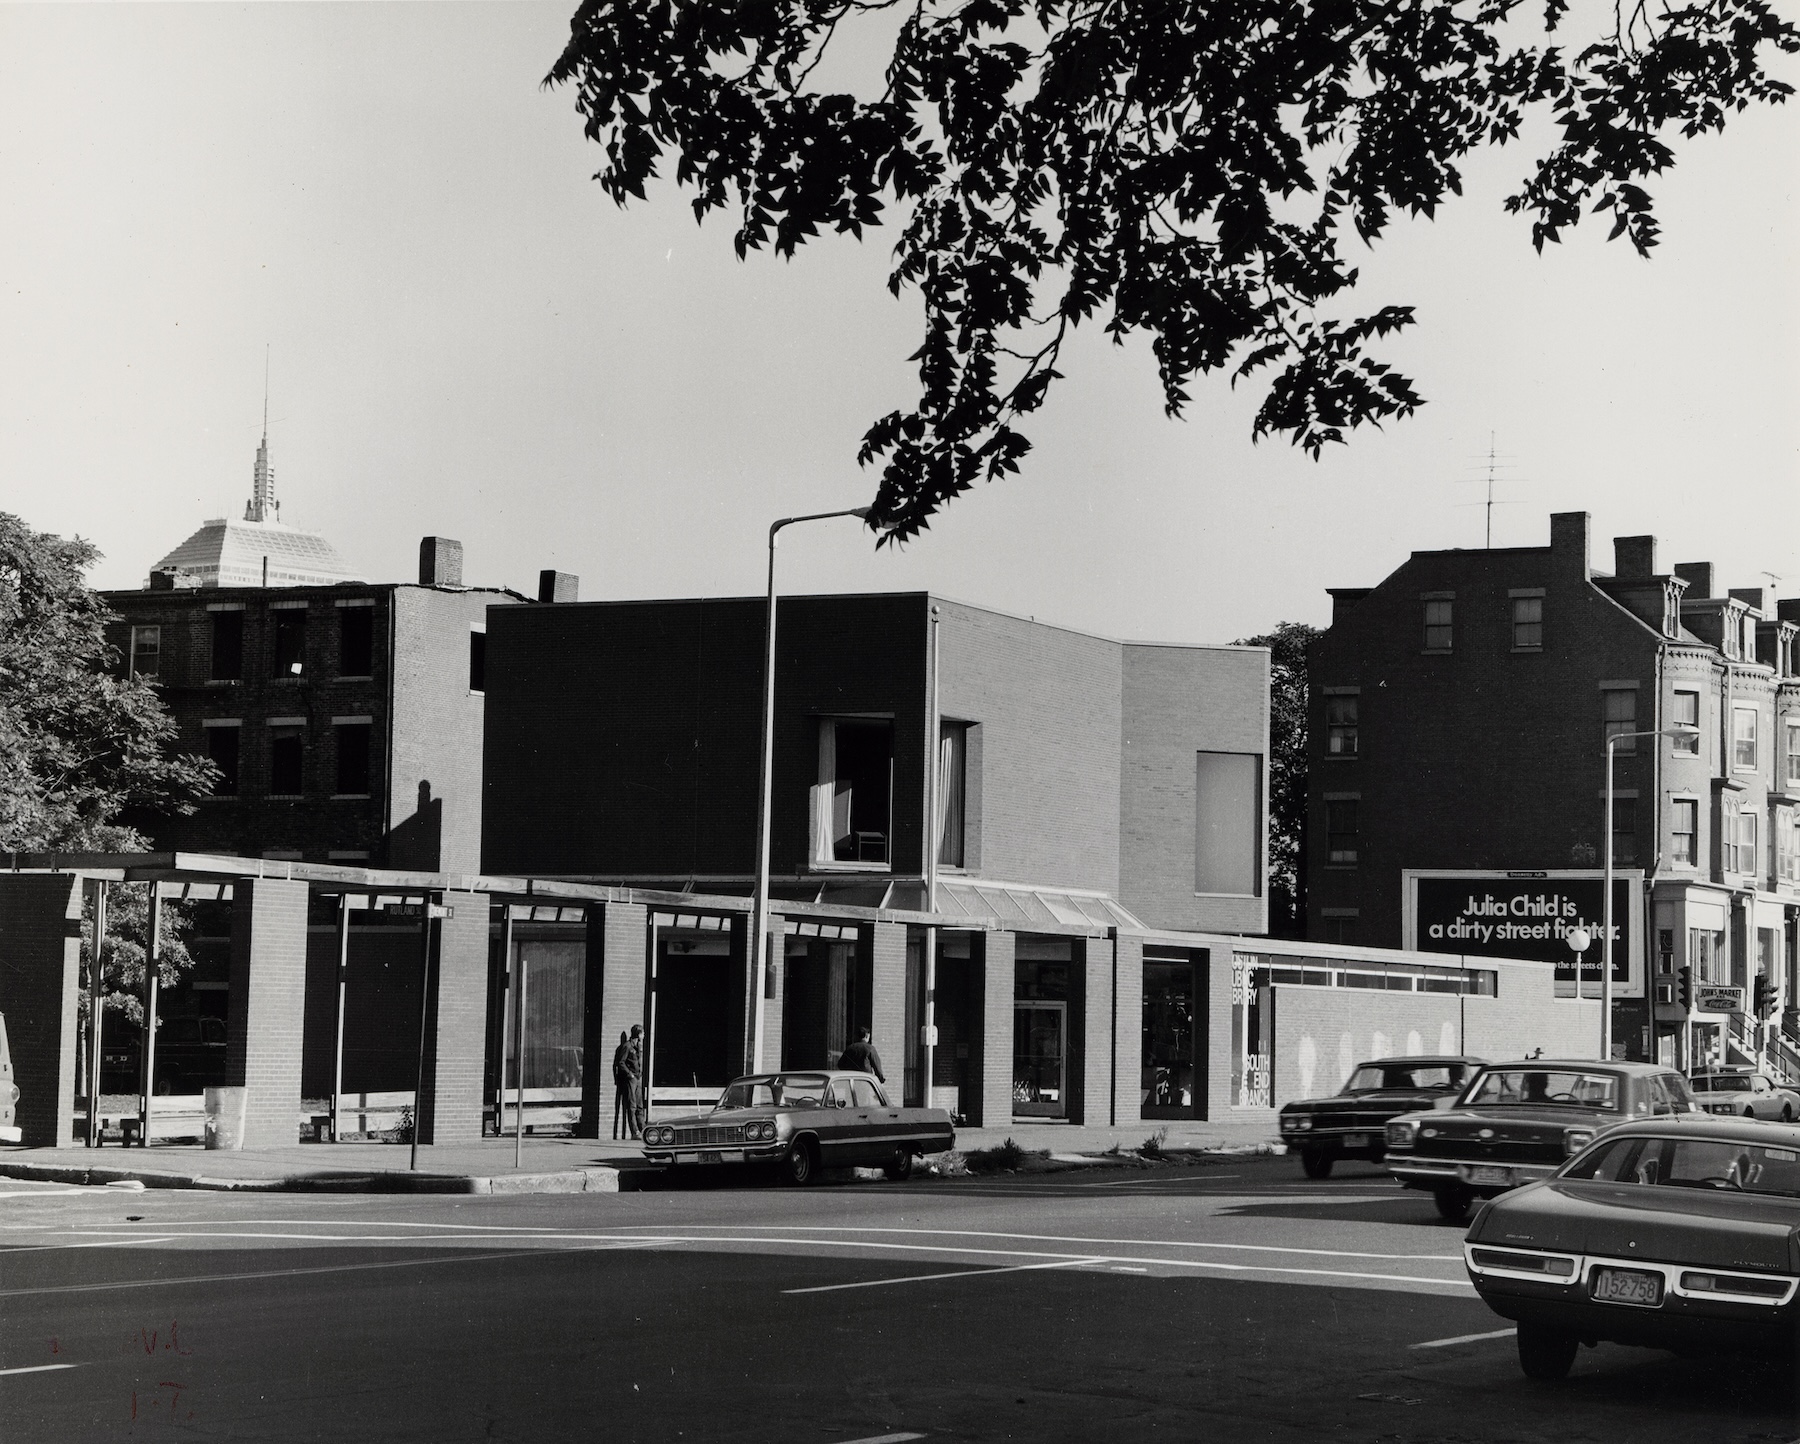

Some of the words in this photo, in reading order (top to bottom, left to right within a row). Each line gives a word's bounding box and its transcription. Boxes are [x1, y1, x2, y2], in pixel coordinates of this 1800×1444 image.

[389, 904, 415, 916] RUTLAND
[1462, 894, 1508, 916] Julia
[1510, 894, 1559, 917] Child
[1562, 896, 1578, 917] is
[1429, 924, 1444, 939] a
[1447, 916, 1495, 944] dirty
[1496, 921, 1551, 939] street
[1231, 954, 1259, 970] OSTON
[1557, 960, 1570, 970] the
[1570, 962, 1596, 970] steets
[1596, 961, 1620, 970] cln.
[1719, 989, 1742, 999] MARKET
[1253, 1071, 1270, 1089] END
[1733, 1260, 1780, 1268] PLYMOUTH
